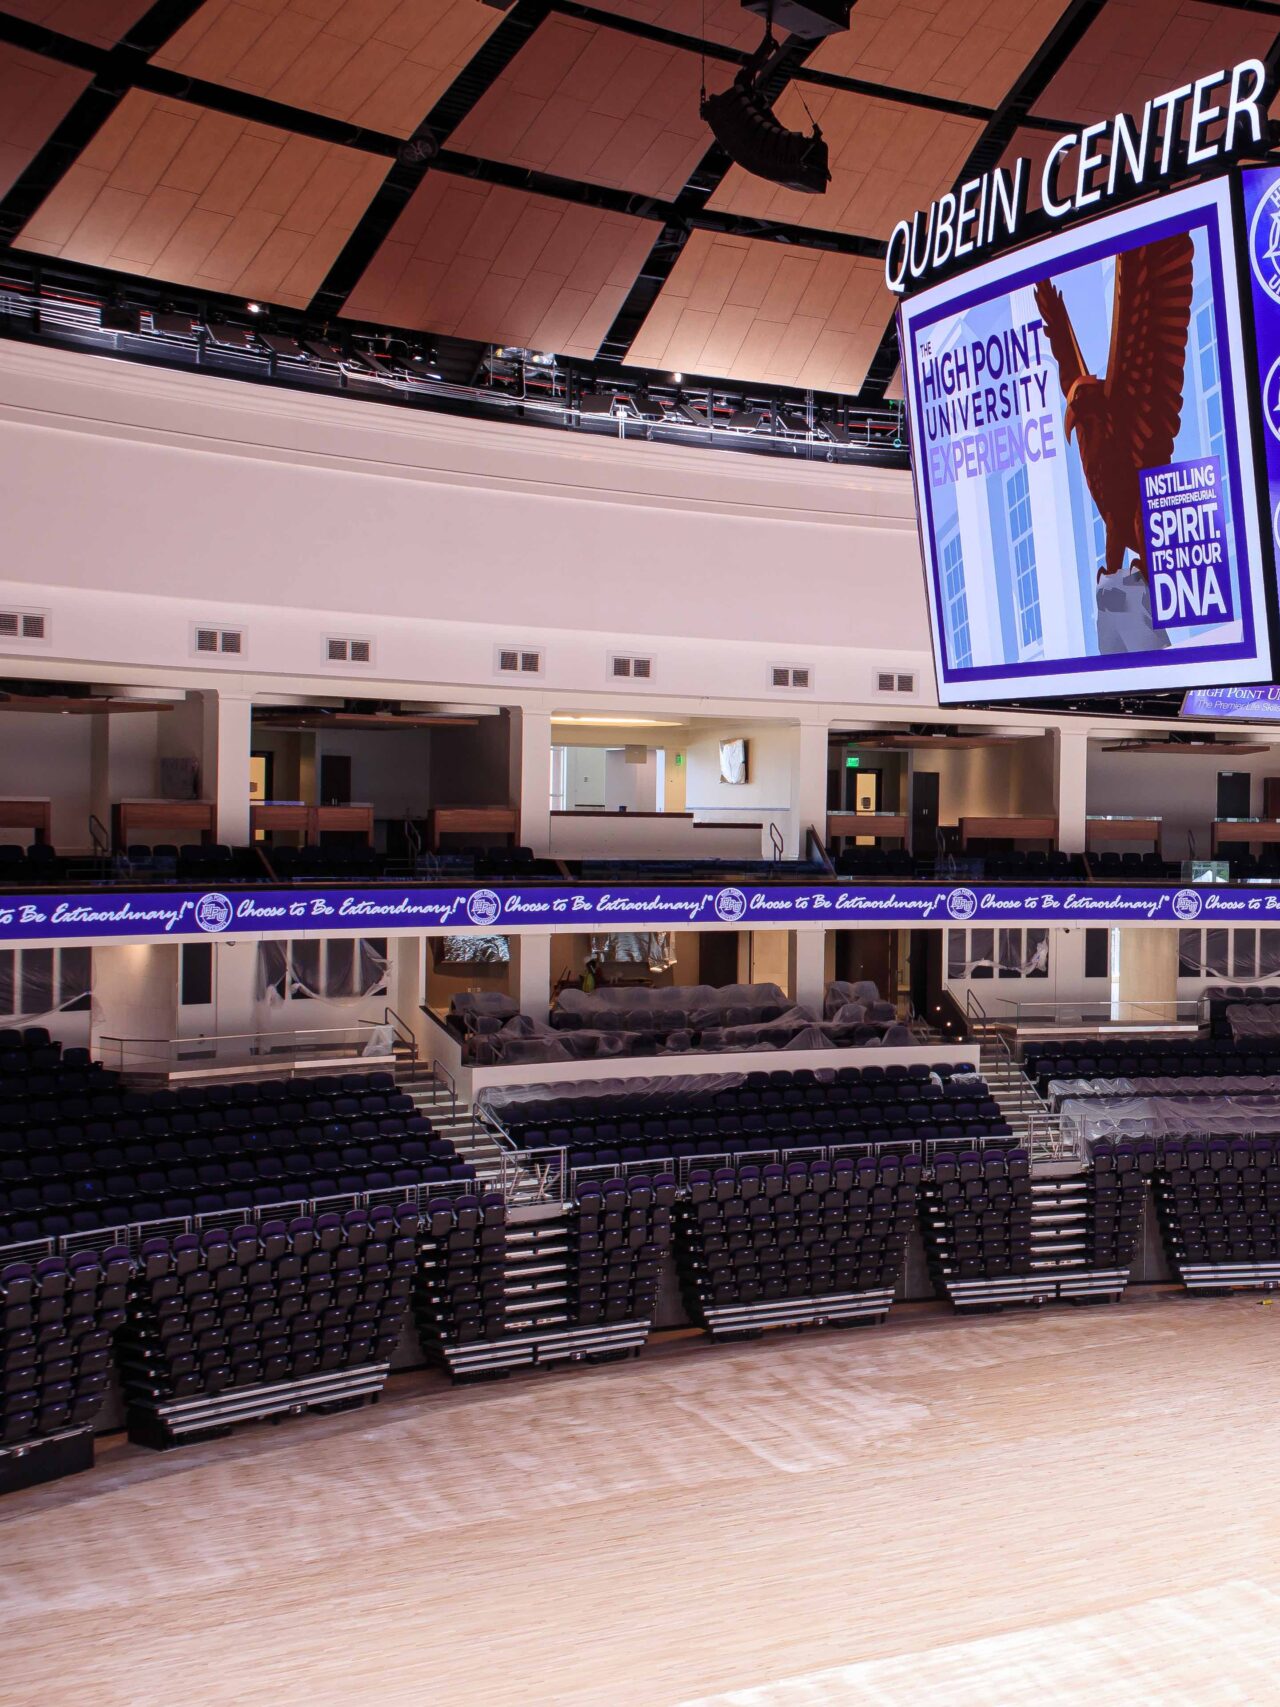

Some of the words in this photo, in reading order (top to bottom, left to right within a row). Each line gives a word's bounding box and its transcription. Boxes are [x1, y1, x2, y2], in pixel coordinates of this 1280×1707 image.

[885, 158, 1022, 291] QUBEIN
[1042, 58, 1267, 217] CENTER
[920, 341, 932, 358] THE
[922, 346, 970, 403] HIGH
[972, 318, 1043, 386] POINT
[925, 370, 1048, 441] UNIVERSITY
[929, 414, 1057, 488] EXPERIENCE
[1145, 465, 1216, 498] INSTILLING
[1147, 498, 1160, 510] THE
[1160, 489, 1217, 508] ENTREPRENEURIAL
[1150, 502, 1221, 547] SPIRIT.
[1151, 549, 1174, 572] IT'S
[1176, 547, 1190, 569] IN
[1192, 543, 1222, 566] OUR
[1153, 566, 1228, 622] DNA
[1226, 687, 1265, 699] POINT
[237, 899, 287, 918] Choose
[290, 902, 308, 916] to
[311, 899, 335, 916] Be
[504, 895, 551, 913] Choose
[553, 899, 569, 912] to
[571, 896, 593, 911] Be
[749, 893, 793, 910] Choose
[795, 896, 811, 909] to
[812, 894, 833, 909] Be
[980, 893, 1023, 909] Choose
[1024, 896, 1040, 909] to
[1041, 894, 1061, 909] Be
[1204, 894, 1246, 910] Choose
[1247, 897, 1263, 910] to
[19, 905, 47, 923] Be
